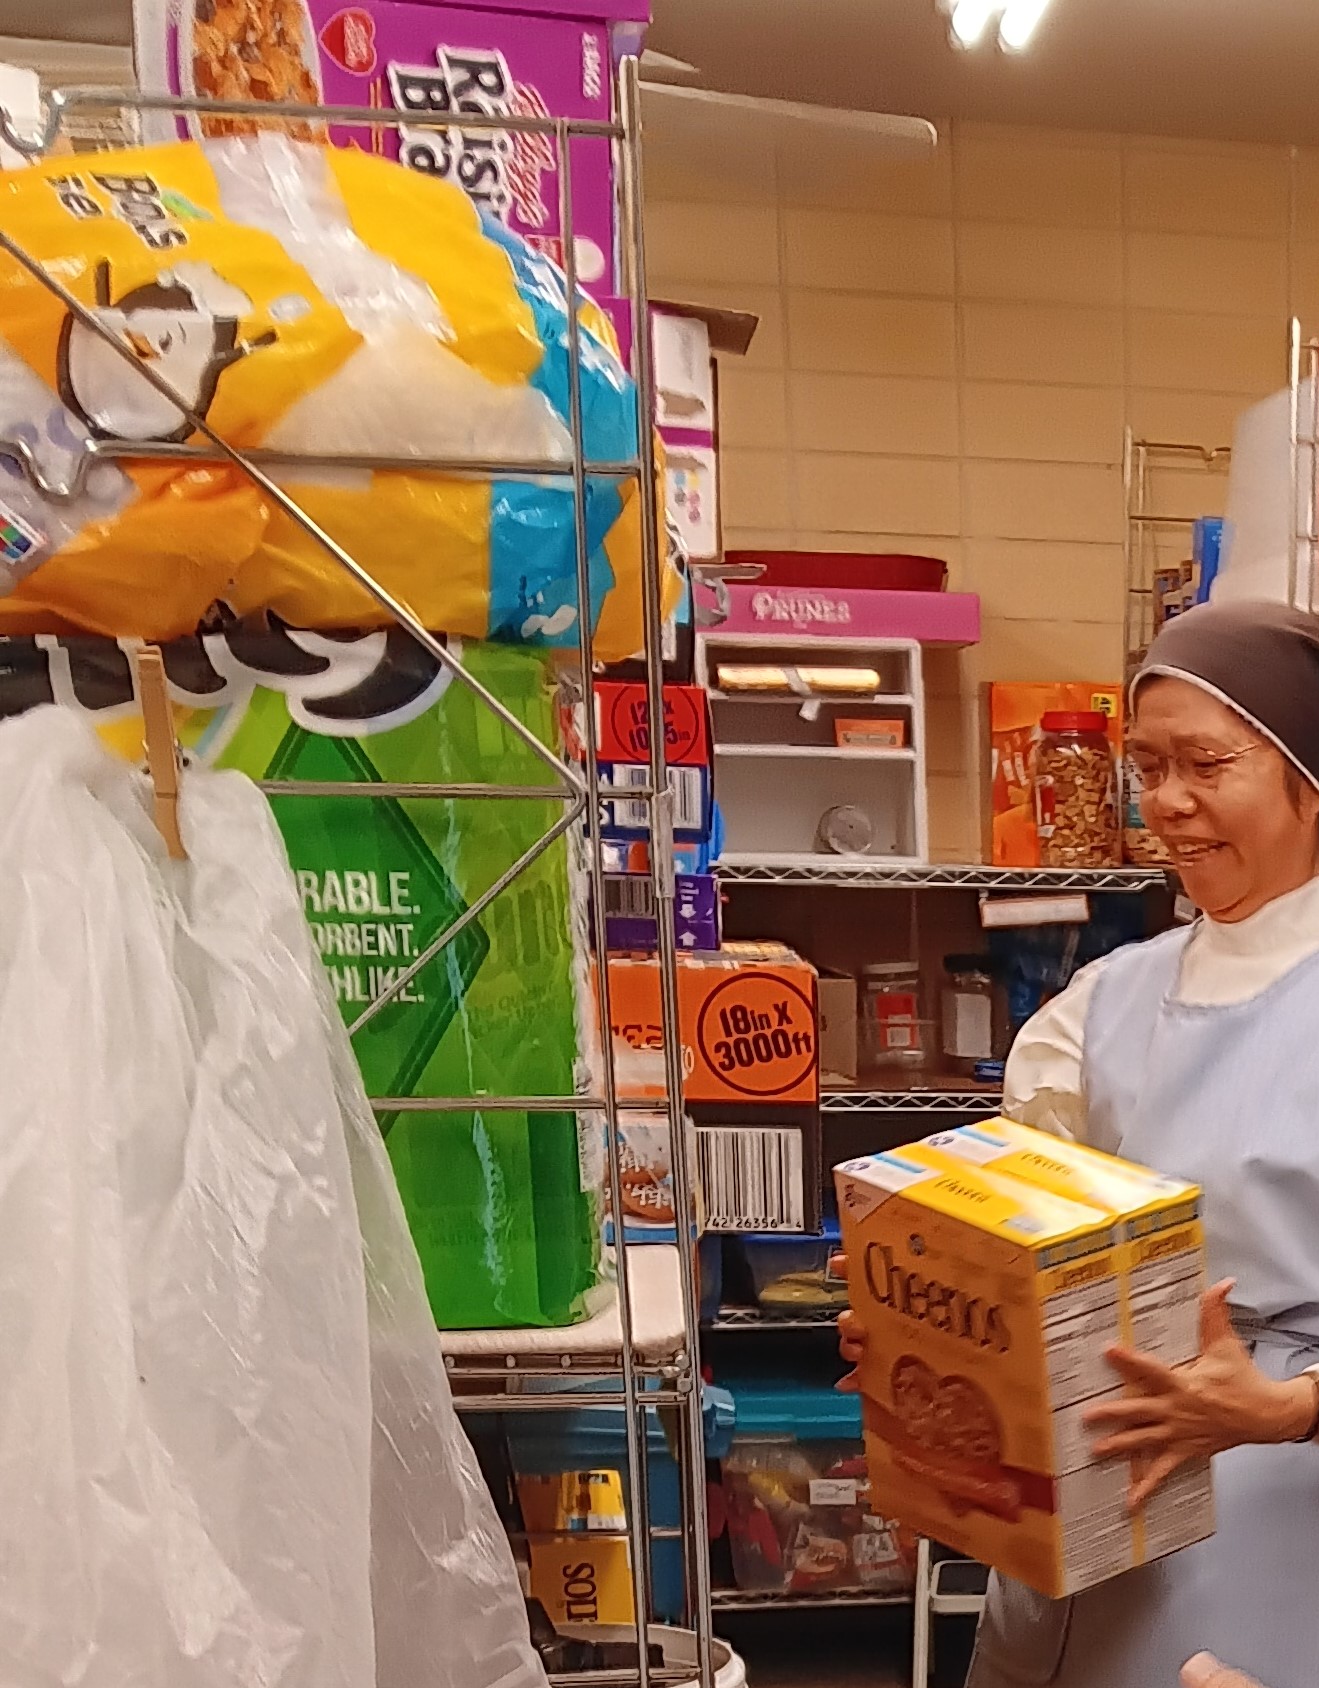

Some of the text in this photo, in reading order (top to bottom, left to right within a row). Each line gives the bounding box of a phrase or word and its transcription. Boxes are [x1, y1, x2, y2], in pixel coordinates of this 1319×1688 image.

[326, 965, 425, 1003] HLIKE.
[718, 1003, 772, 1039] 18in
[714, 1028, 813, 1072] 3000ft
